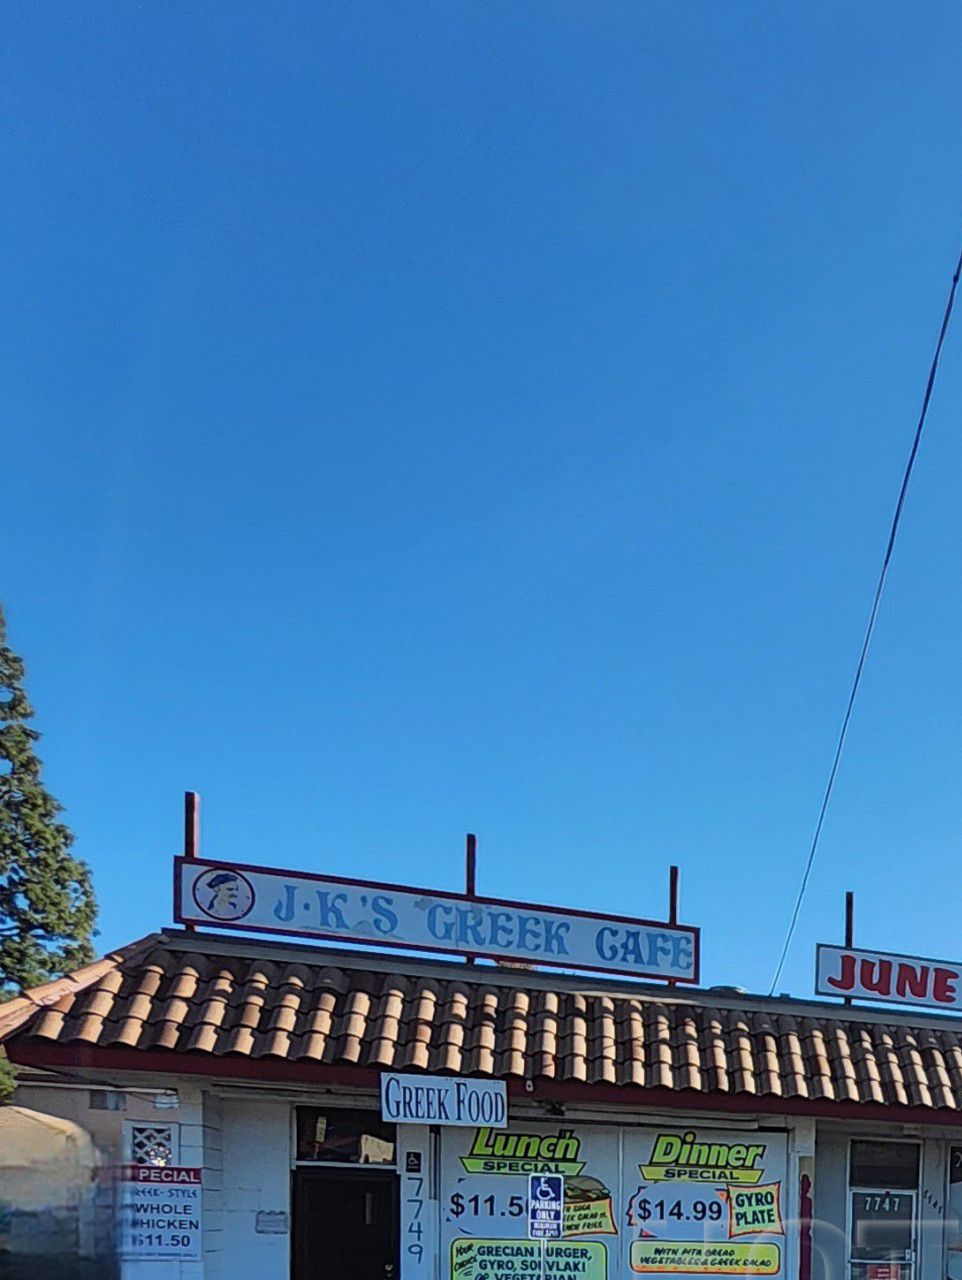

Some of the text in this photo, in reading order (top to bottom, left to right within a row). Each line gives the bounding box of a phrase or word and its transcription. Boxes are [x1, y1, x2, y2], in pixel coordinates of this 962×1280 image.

[428, 903, 570, 955] GREEK
[595, 926, 693, 971] CAFE
[827, 954, 960, 1004] JUNE
[384, 1077, 505, 1123] GREEK FOOD
[470, 1127, 581, 1161] Lunch
[648, 1130, 767, 1169] Dinner
[482, 1161, 566, 1174] SPECIAL
[664, 1168, 740, 1180] SPECIAL
[138, 1168, 200, 1183] PECIAL
[168, 1188, 198, 1198] STYLE
[735, 1191, 775, 1207] GYRO
[135, 1203, 193, 1215] WHOLE
[450, 1192, 529, 1219] $11.5
[531, 1200, 561, 1211] PARKING
[637, 1198, 722, 1222] $14.99
[865, 1197, 900, 1212] 7747
[406, 1176, 424, 1265] 7749
[536, 1211, 556, 1220] ONLY
[735, 1209, 776, 1227] PLATE
[133, 1219, 200, 1230] HICKEN
[477, 1245, 593, 1261] GRECIAN URGER,
[653, 1247, 678, 1256] WITH
[478, 1260, 517, 1272] GYRO,
[710, 1258, 743, 1267] GREEK
